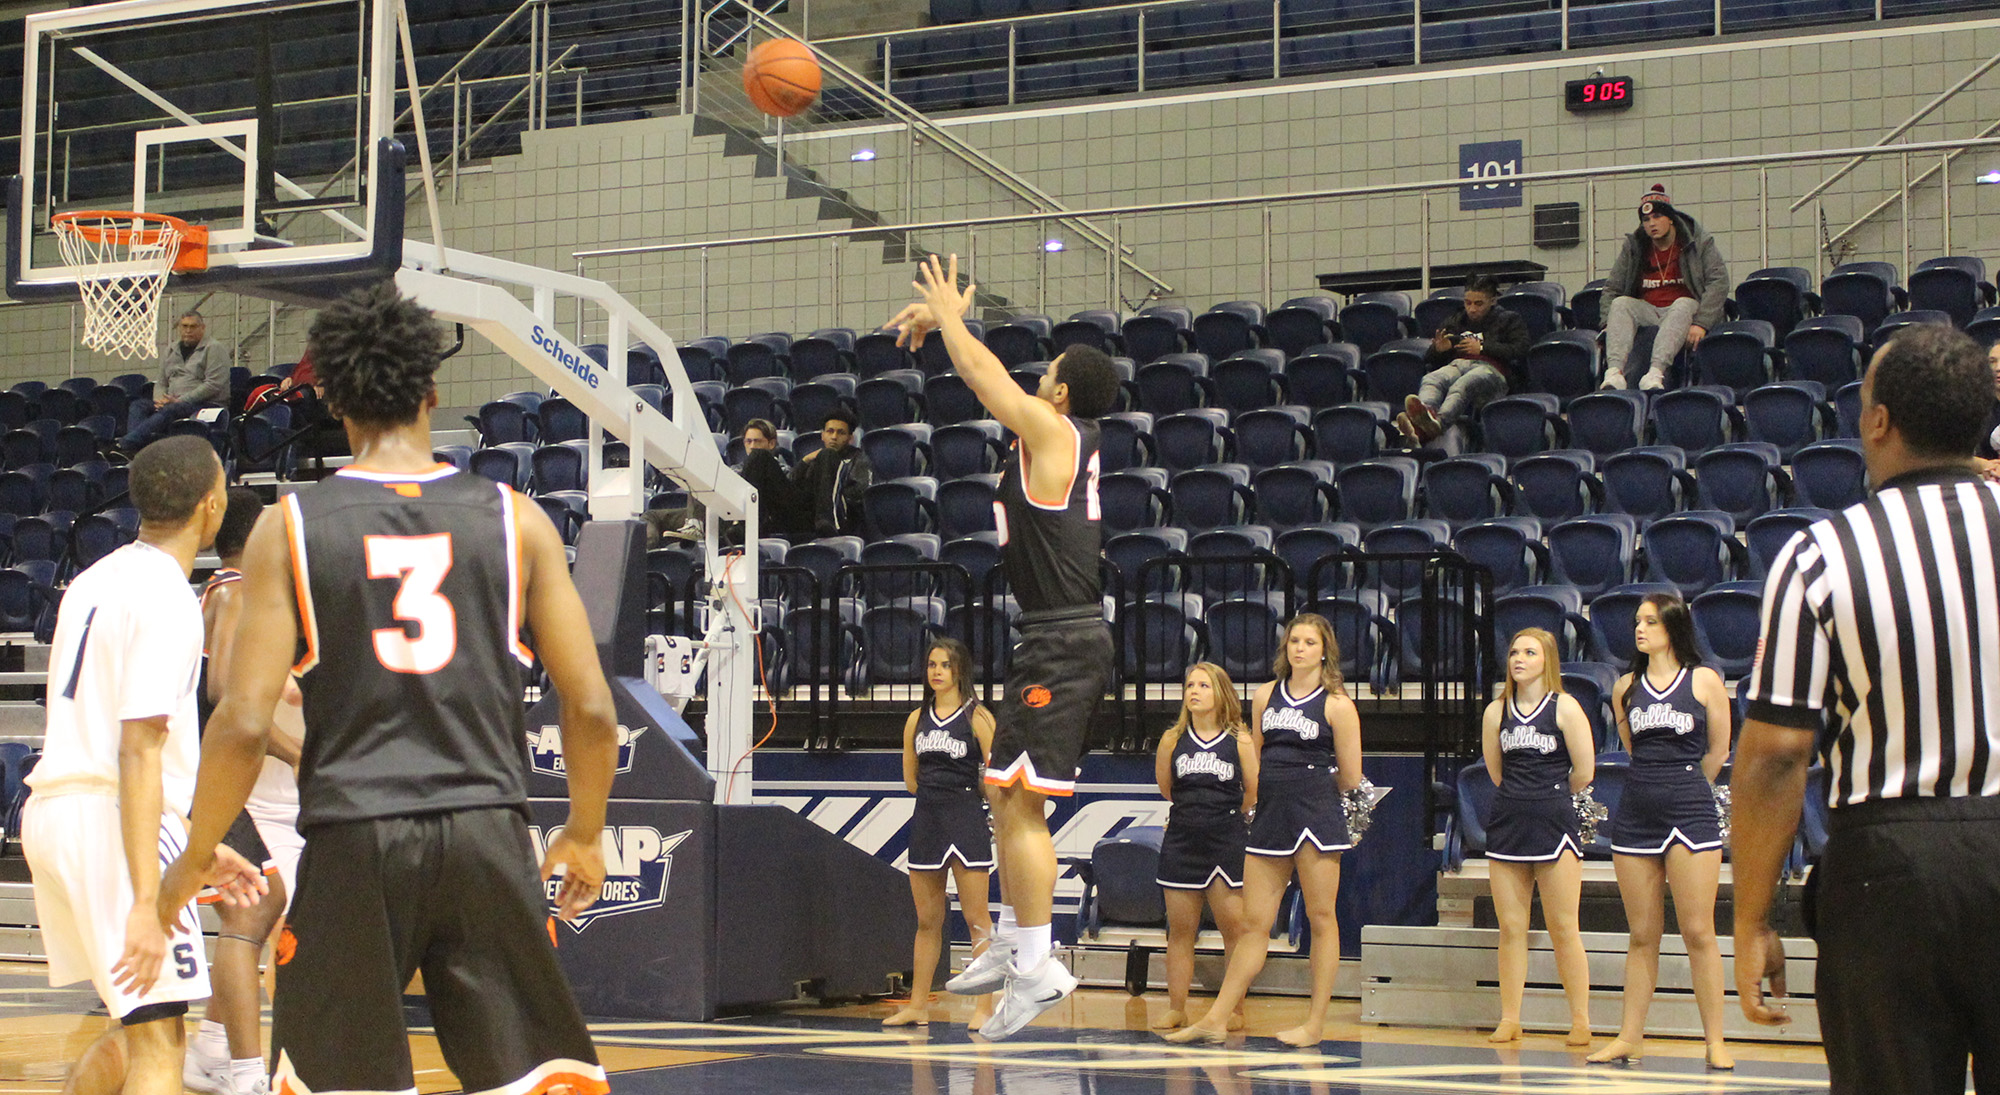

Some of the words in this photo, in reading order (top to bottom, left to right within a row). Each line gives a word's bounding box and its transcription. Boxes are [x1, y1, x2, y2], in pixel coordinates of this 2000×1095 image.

[1467, 160, 1516, 190] 101
[531, 325, 599, 389] Schelde
[363, 532, 457, 674] 3
[1261, 707, 1319, 740] Bulldogs
[1629, 703, 1694, 735] Bulldogs
[915, 730, 967, 759] Bulldogs
[1499, 725, 1557, 755] Bulldogs
[1175, 752, 1234, 782] Bulldogs
[173, 943, 198, 979] S
